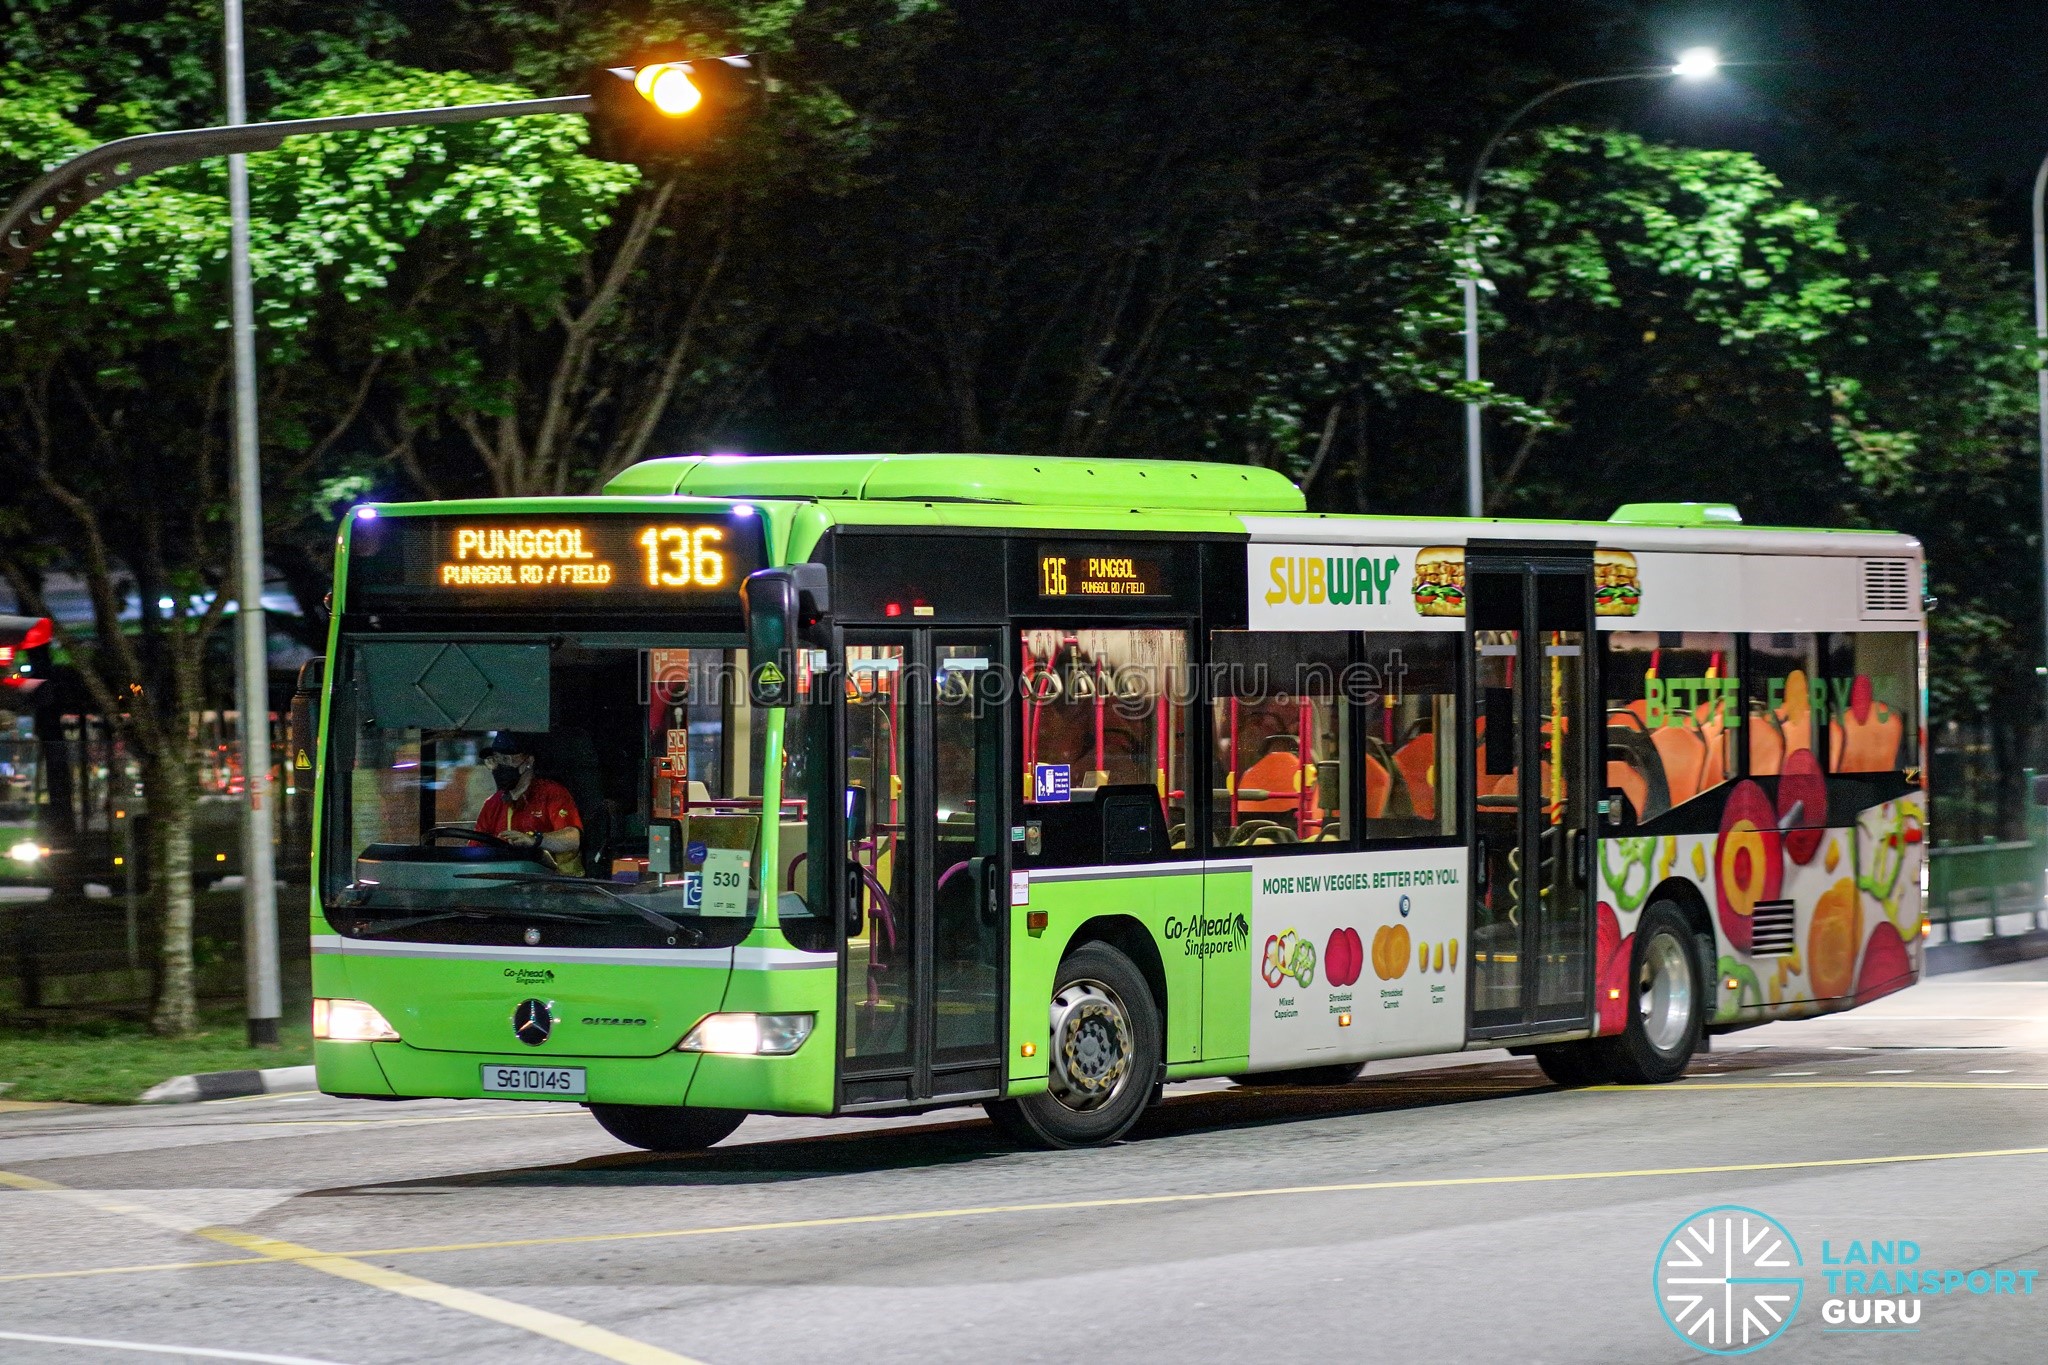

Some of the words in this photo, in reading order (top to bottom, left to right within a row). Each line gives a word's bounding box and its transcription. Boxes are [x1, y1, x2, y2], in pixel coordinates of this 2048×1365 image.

[458, 528, 594, 560] PUNGGOL
[640, 526, 725, 586] 136
[443, 564, 515, 585] PUNGGOL
[520, 564, 543, 585] RD
[560, 564, 612, 585] FIELD
[1043, 557, 1067, 595] 136
[1089, 558, 1137, 578] PUNGGOL
[1081, 582, 1110, 594] PUNGGOL
[1111, 582, 1120, 594] RD
[1126, 582, 1145, 594] FIELD
[1264, 554, 1401, 609] SUBWAY
[1645, 677, 1741, 729] BETTE
[713, 871, 740, 888] 530
[1263, 877, 1294, 895] MORE
[1296, 876, 1321, 893] NEW
[1323, 873, 1371, 891] VEGGIES.
[1373, 871, 1411, 889] BETTER
[1413, 870, 1434, 886] FOR
[1435, 868, 1460, 885] YOU.
[1164, 912, 1232, 940] Go-Ahead
[1184, 938, 1234, 960] Singapore
[503, 968, 544, 978] Go-Ahead
[516, 977, 546, 985] Singapore
[1380, 988, 1403, 998] Shredded
[1430, 984, 1446, 993] Sweet
[1278, 997, 1294, 1007] Mixed
[1329, 993, 1352, 1003] Shredded
[1383, 1000, 1399, 1010] Carrot
[1274, 1009, 1298, 1019] Capsicum
[1329, 1005, 1352, 1014] Beetroot
[497, 1069, 571, 1090] SG1014S
